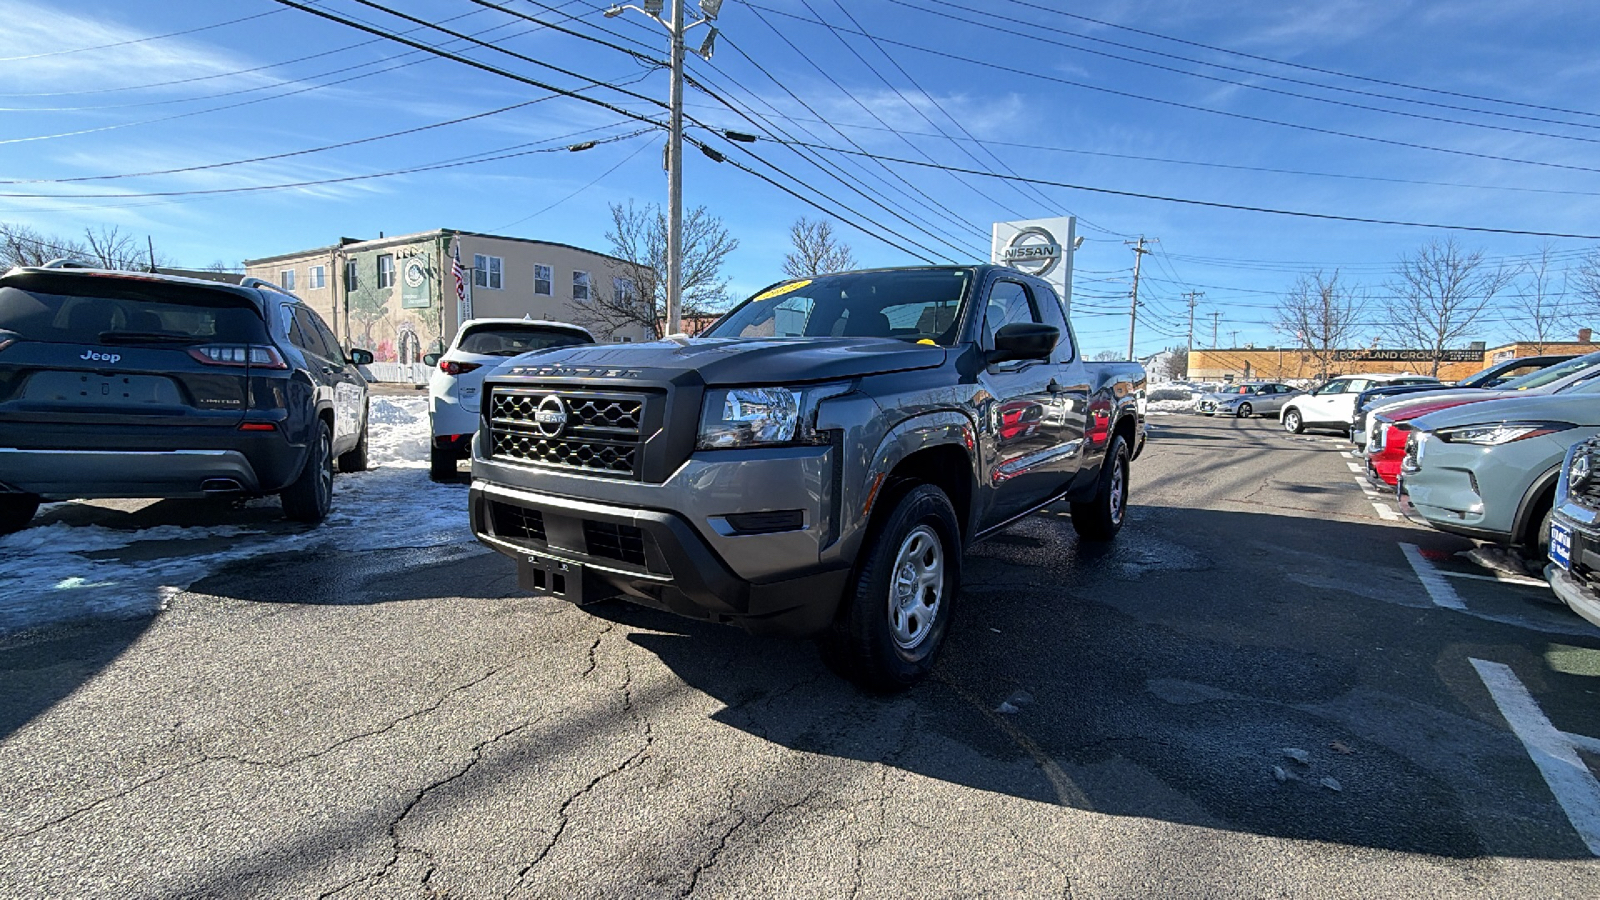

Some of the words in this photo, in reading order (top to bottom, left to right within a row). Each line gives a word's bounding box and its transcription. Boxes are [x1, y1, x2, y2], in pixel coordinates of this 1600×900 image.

[1005, 246, 1054, 258] NISSAN
[80, 350, 121, 364] Jeep
[1400, 351, 1442, 359] GROUP
[507, 367, 643, 377] FRONTIER
[536, 413, 566, 422] ISSAN
